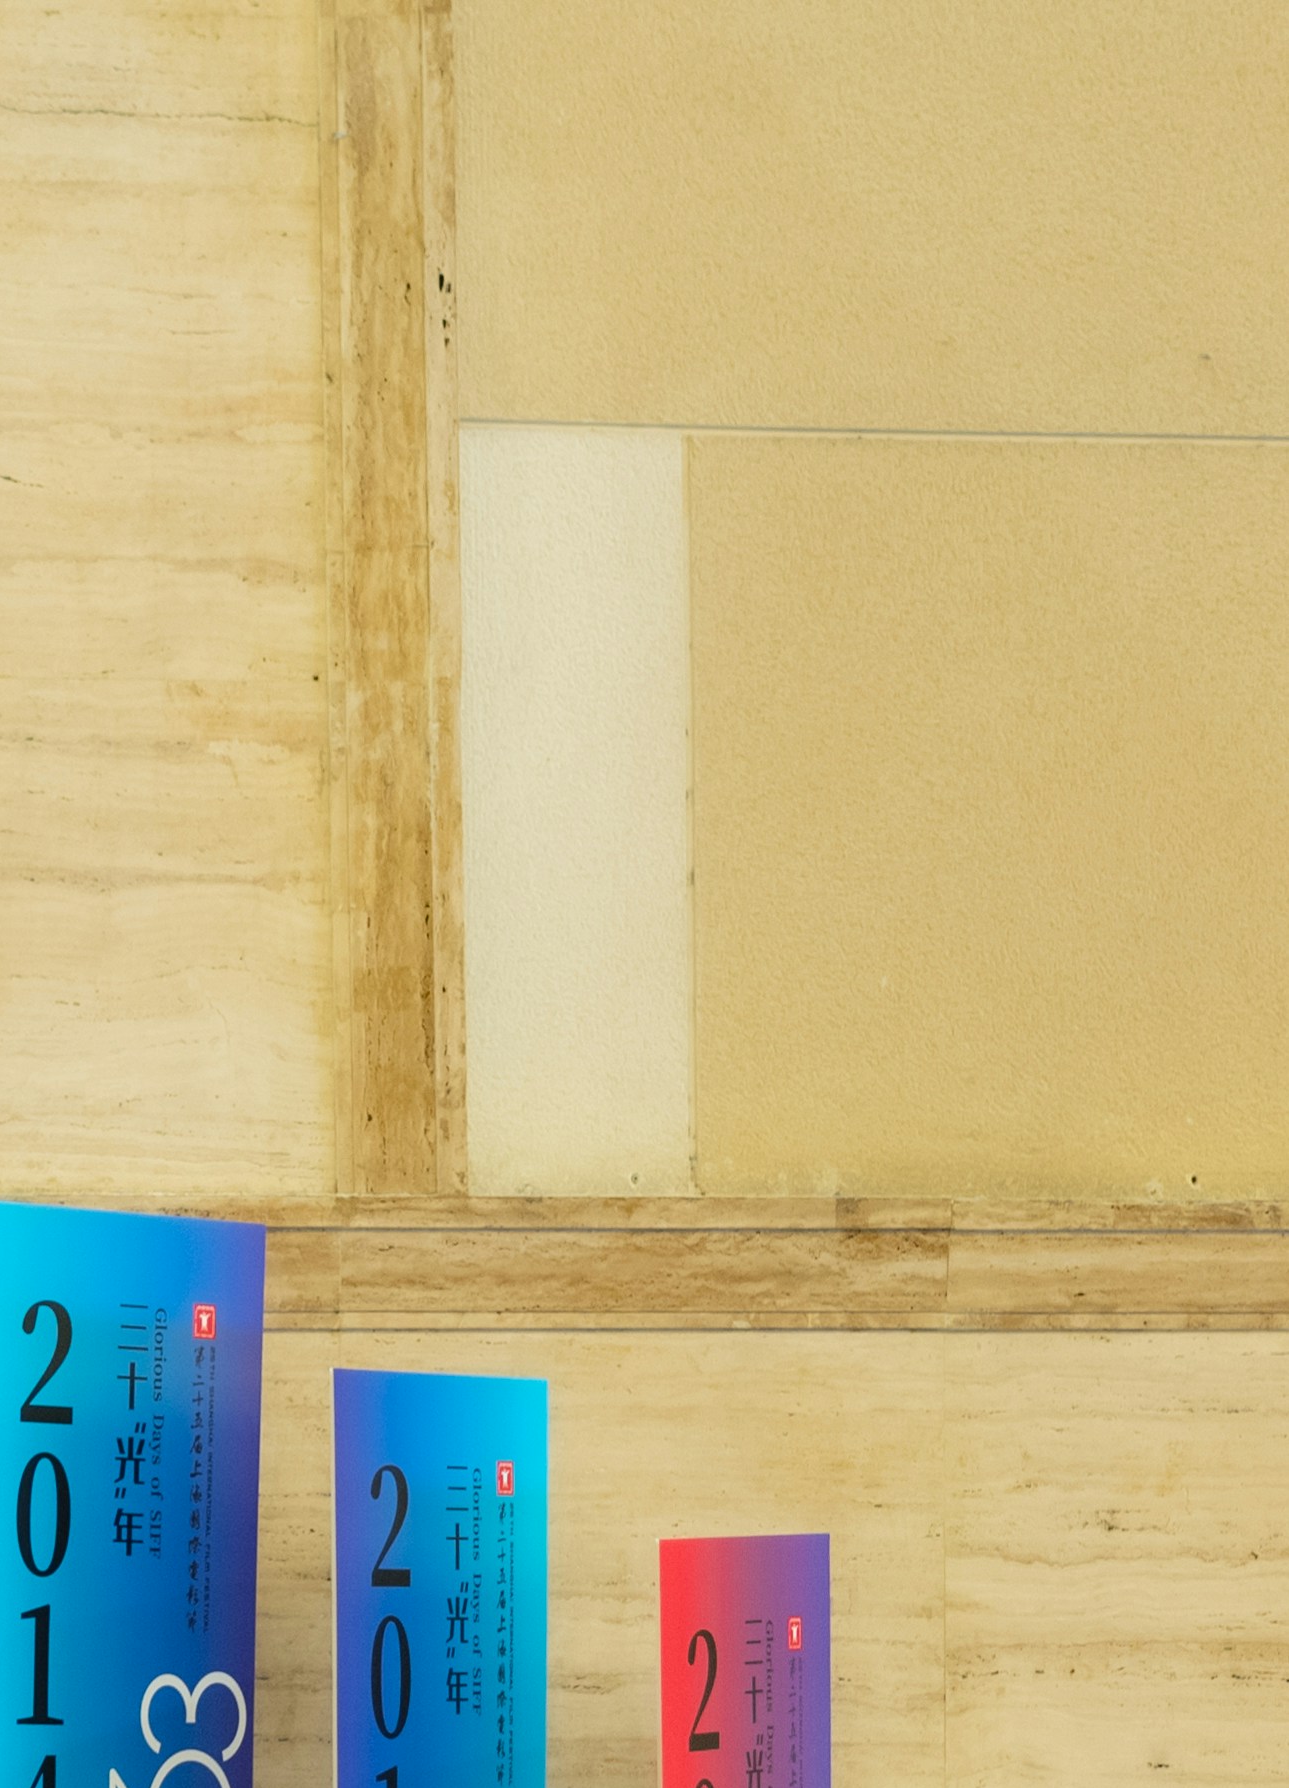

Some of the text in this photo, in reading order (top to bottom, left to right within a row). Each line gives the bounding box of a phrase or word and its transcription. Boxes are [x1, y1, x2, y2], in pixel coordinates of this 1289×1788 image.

[148, 1308, 168, 1560] Glorious Days of SIFF
[469, 1468, 482, 1717] Glorious Days of SIFF
[766, 1620, 774, 1712] Glorious
[766, 1725, 775, 1774] Days
